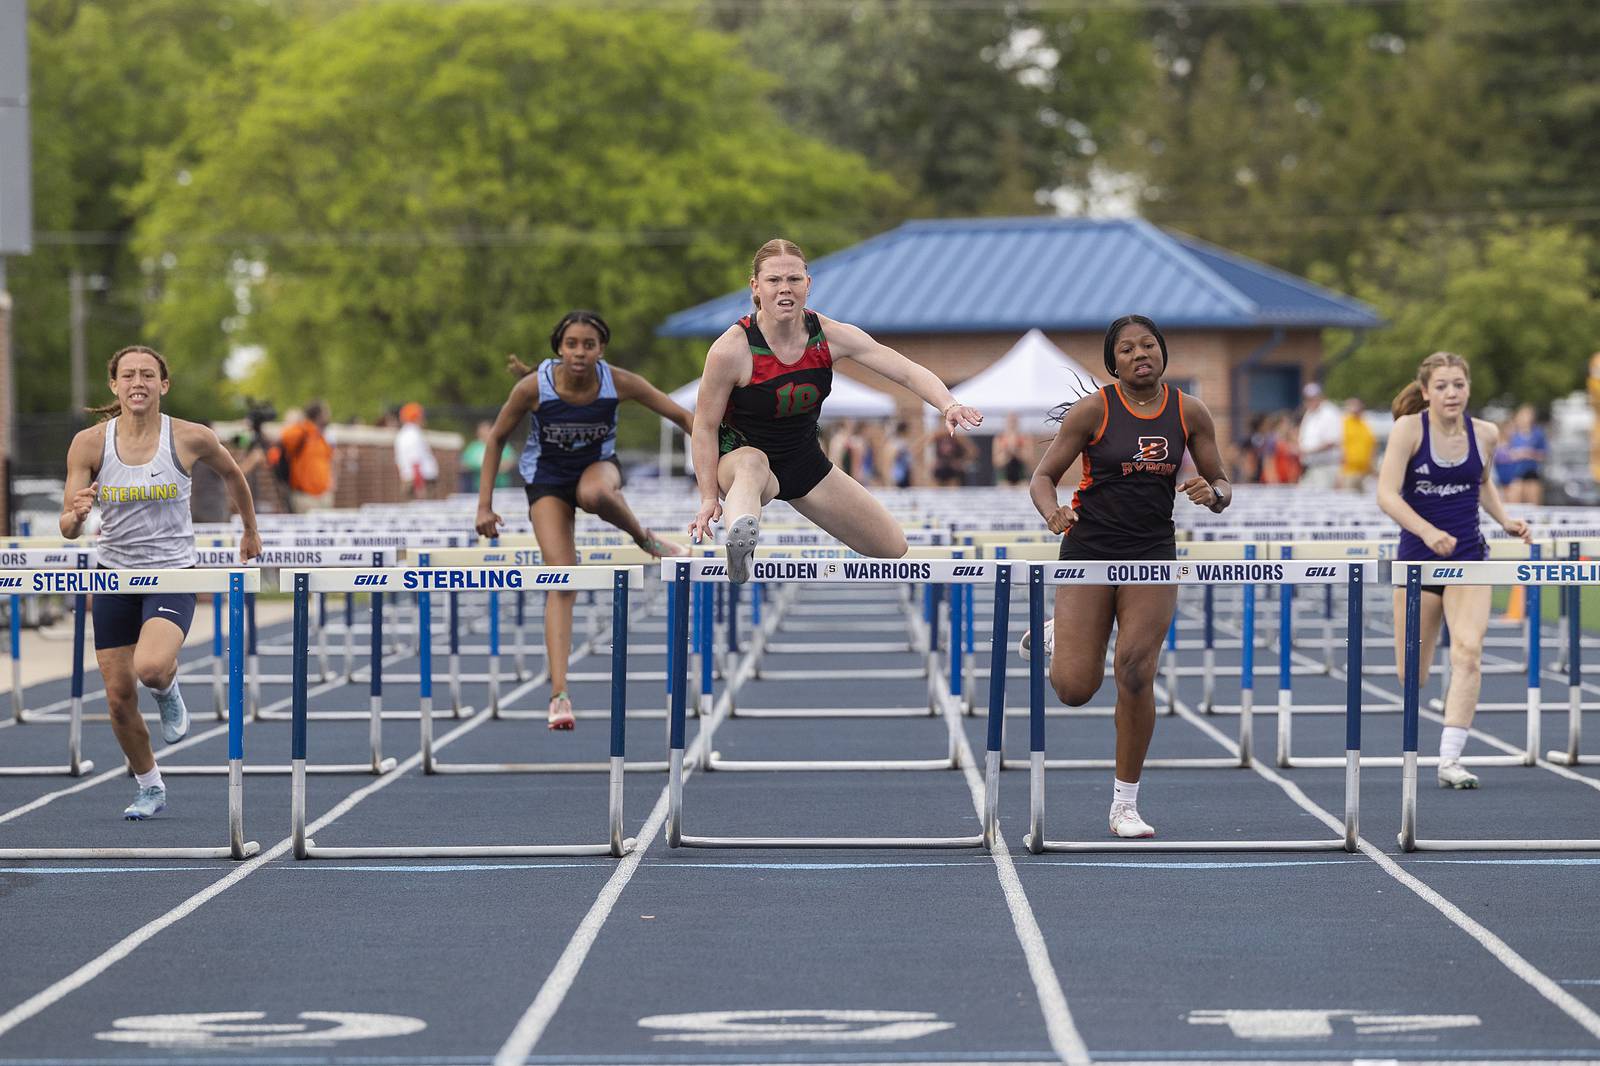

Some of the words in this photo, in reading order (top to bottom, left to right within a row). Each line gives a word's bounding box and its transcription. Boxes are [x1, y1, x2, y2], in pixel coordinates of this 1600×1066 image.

[102, 483, 178, 503] STERLING
[255, 551, 322, 564] WARRIORS
[353, 574, 389, 586] GILL
[403, 569, 523, 589] STERLING
[535, 572, 571, 584] GILL
[754, 562, 818, 579] GOLDEN
[843, 562, 931, 579] WARRIORS
[952, 565, 985, 577] GILL
[1053, 567, 1086, 579] GILL
[1107, 564, 1171, 582] GOLDEN
[1195, 564, 1284, 581] WARRIORS
[1304, 566, 1337, 577] GILL
[1432, 567, 1464, 578] GILL
[1516, 564, 1600, 581] STERLI
[32, 572, 119, 592] STERLING
[128, 576, 159, 586] GILL
